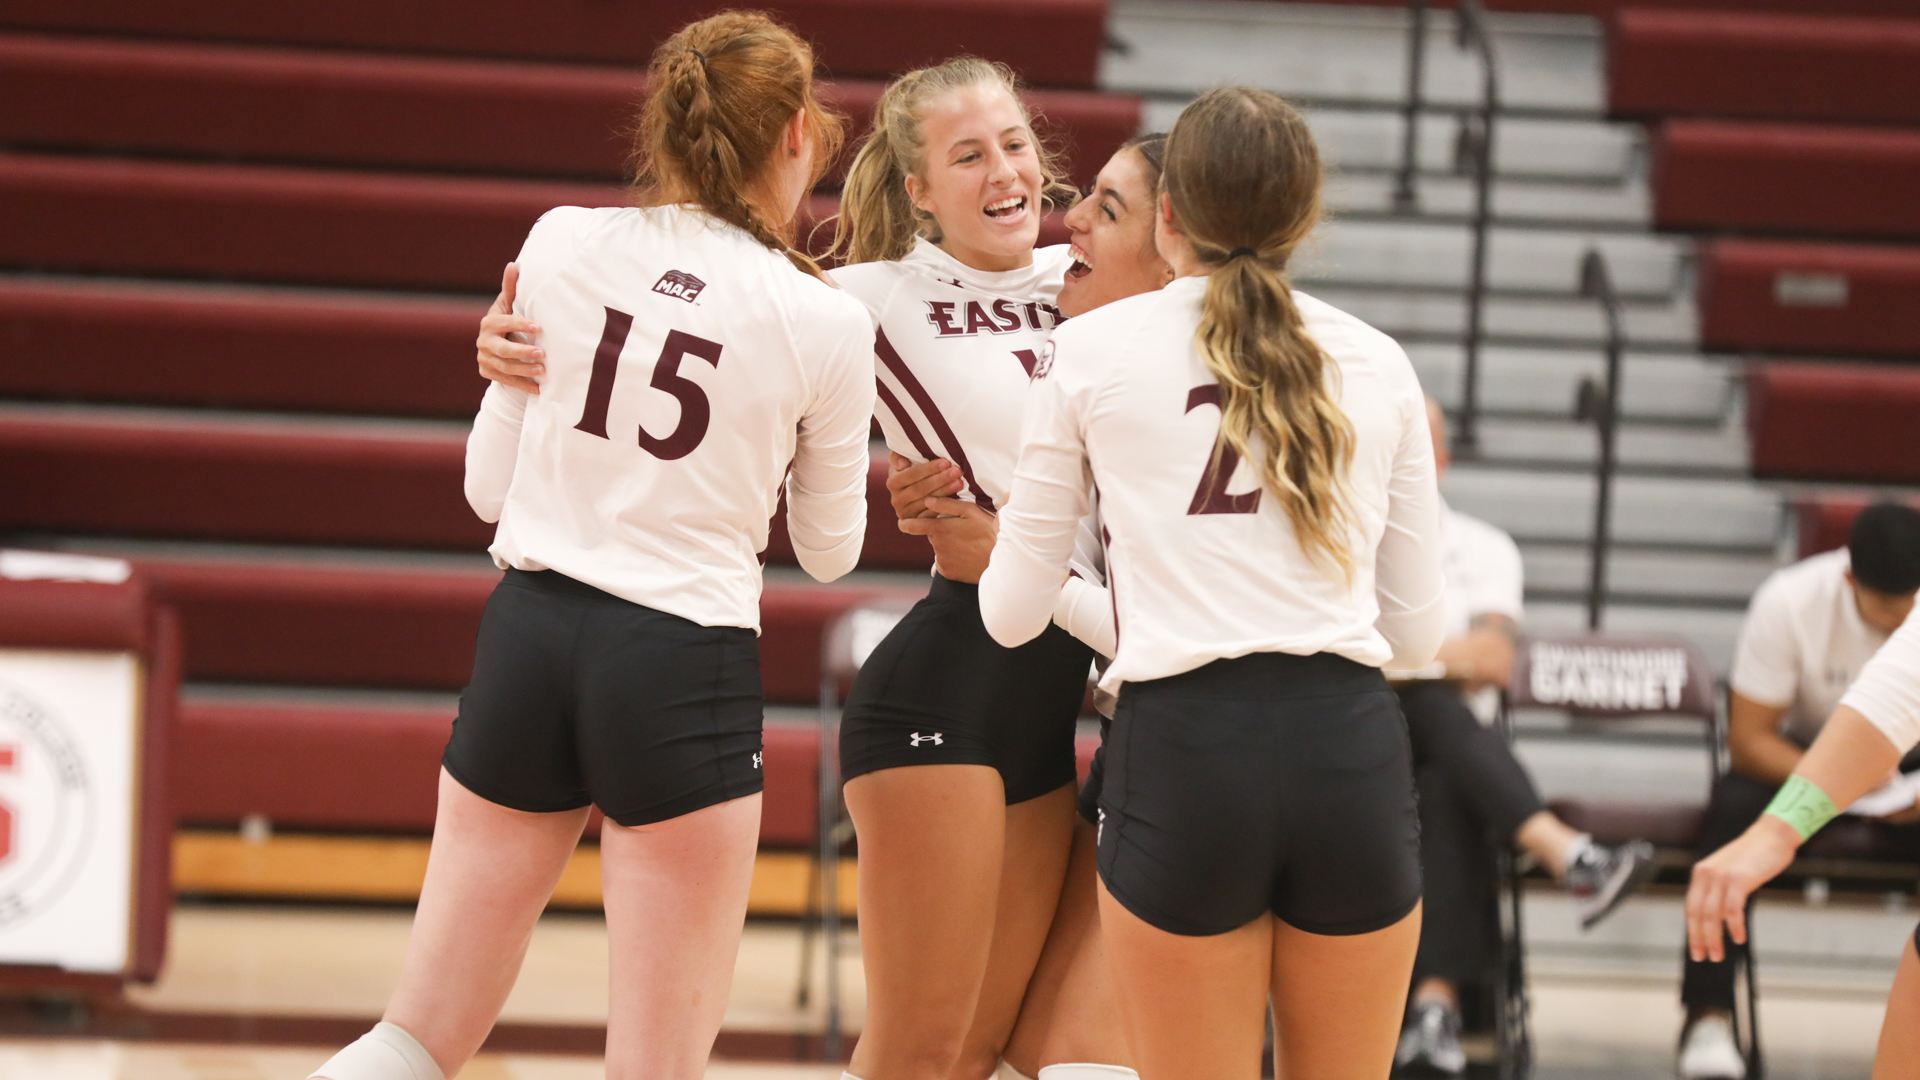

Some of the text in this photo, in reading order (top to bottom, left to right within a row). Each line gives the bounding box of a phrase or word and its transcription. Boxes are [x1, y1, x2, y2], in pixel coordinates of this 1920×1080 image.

[654, 279, 698, 301] MAC
[573, 305, 723, 461] 15
[1184, 383, 1262, 515] 2
[1531, 667, 1687, 710] GARNET
